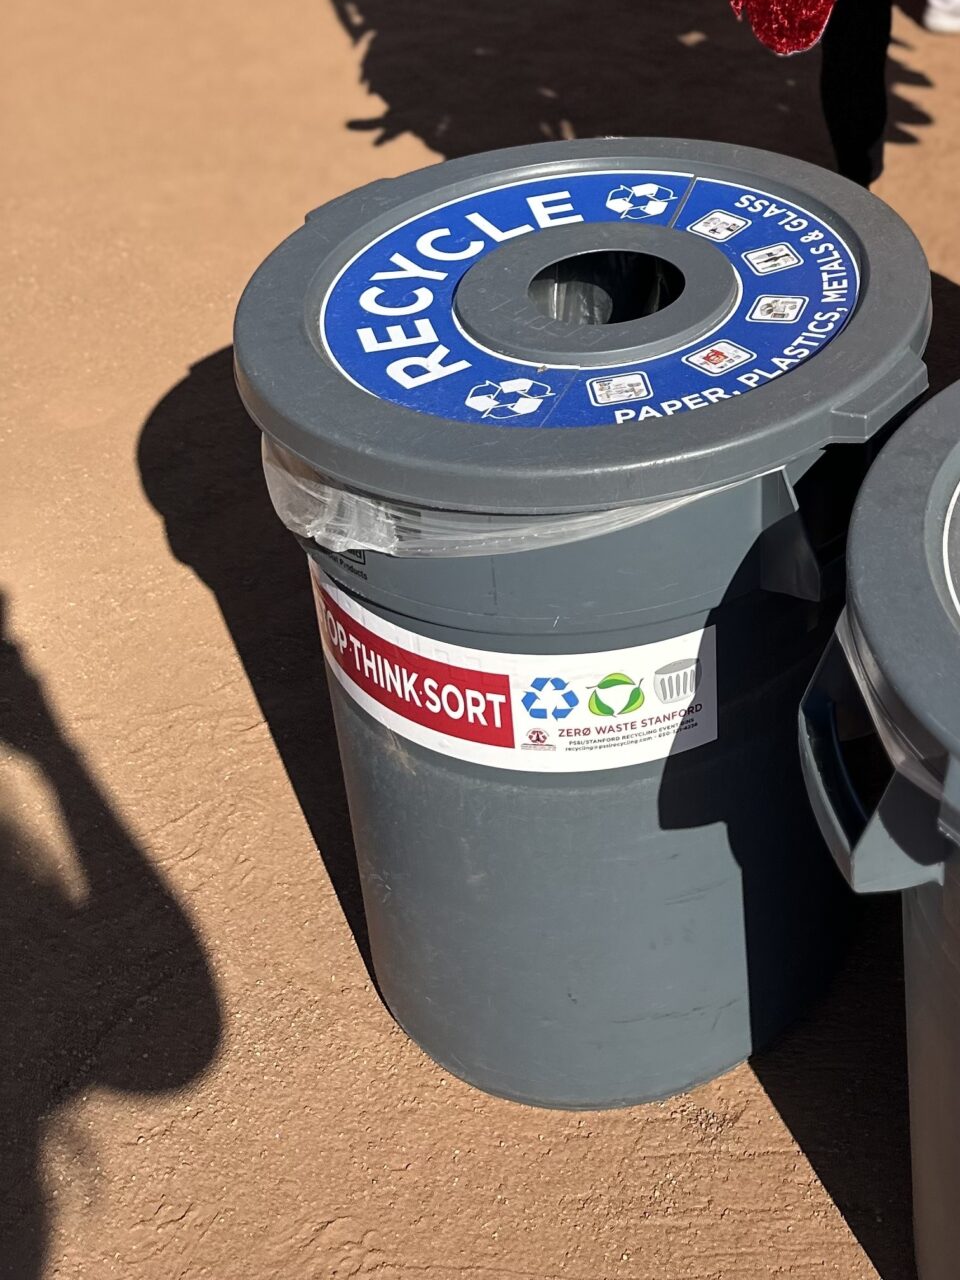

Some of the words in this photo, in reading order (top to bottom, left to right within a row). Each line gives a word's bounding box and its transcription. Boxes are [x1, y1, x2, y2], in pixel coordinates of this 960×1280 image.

[734, 194, 809, 232] GLASS
[800, 229, 824, 243] &
[357, 190, 585, 390] RECYCLE
[810, 242, 849, 303] METALS
[737, 307, 849, 389] PLASTICS,
[613, 386, 741, 424] PAPER,
[348, 633, 423, 704] THINK
[423, 676, 507, 729] SORT
[594, 720, 638, 735] WASTE
[641, 703, 703, 727] STANFORD
[621, 729, 657, 741] RECYCLING
[658, 722, 680, 734] EVENT
